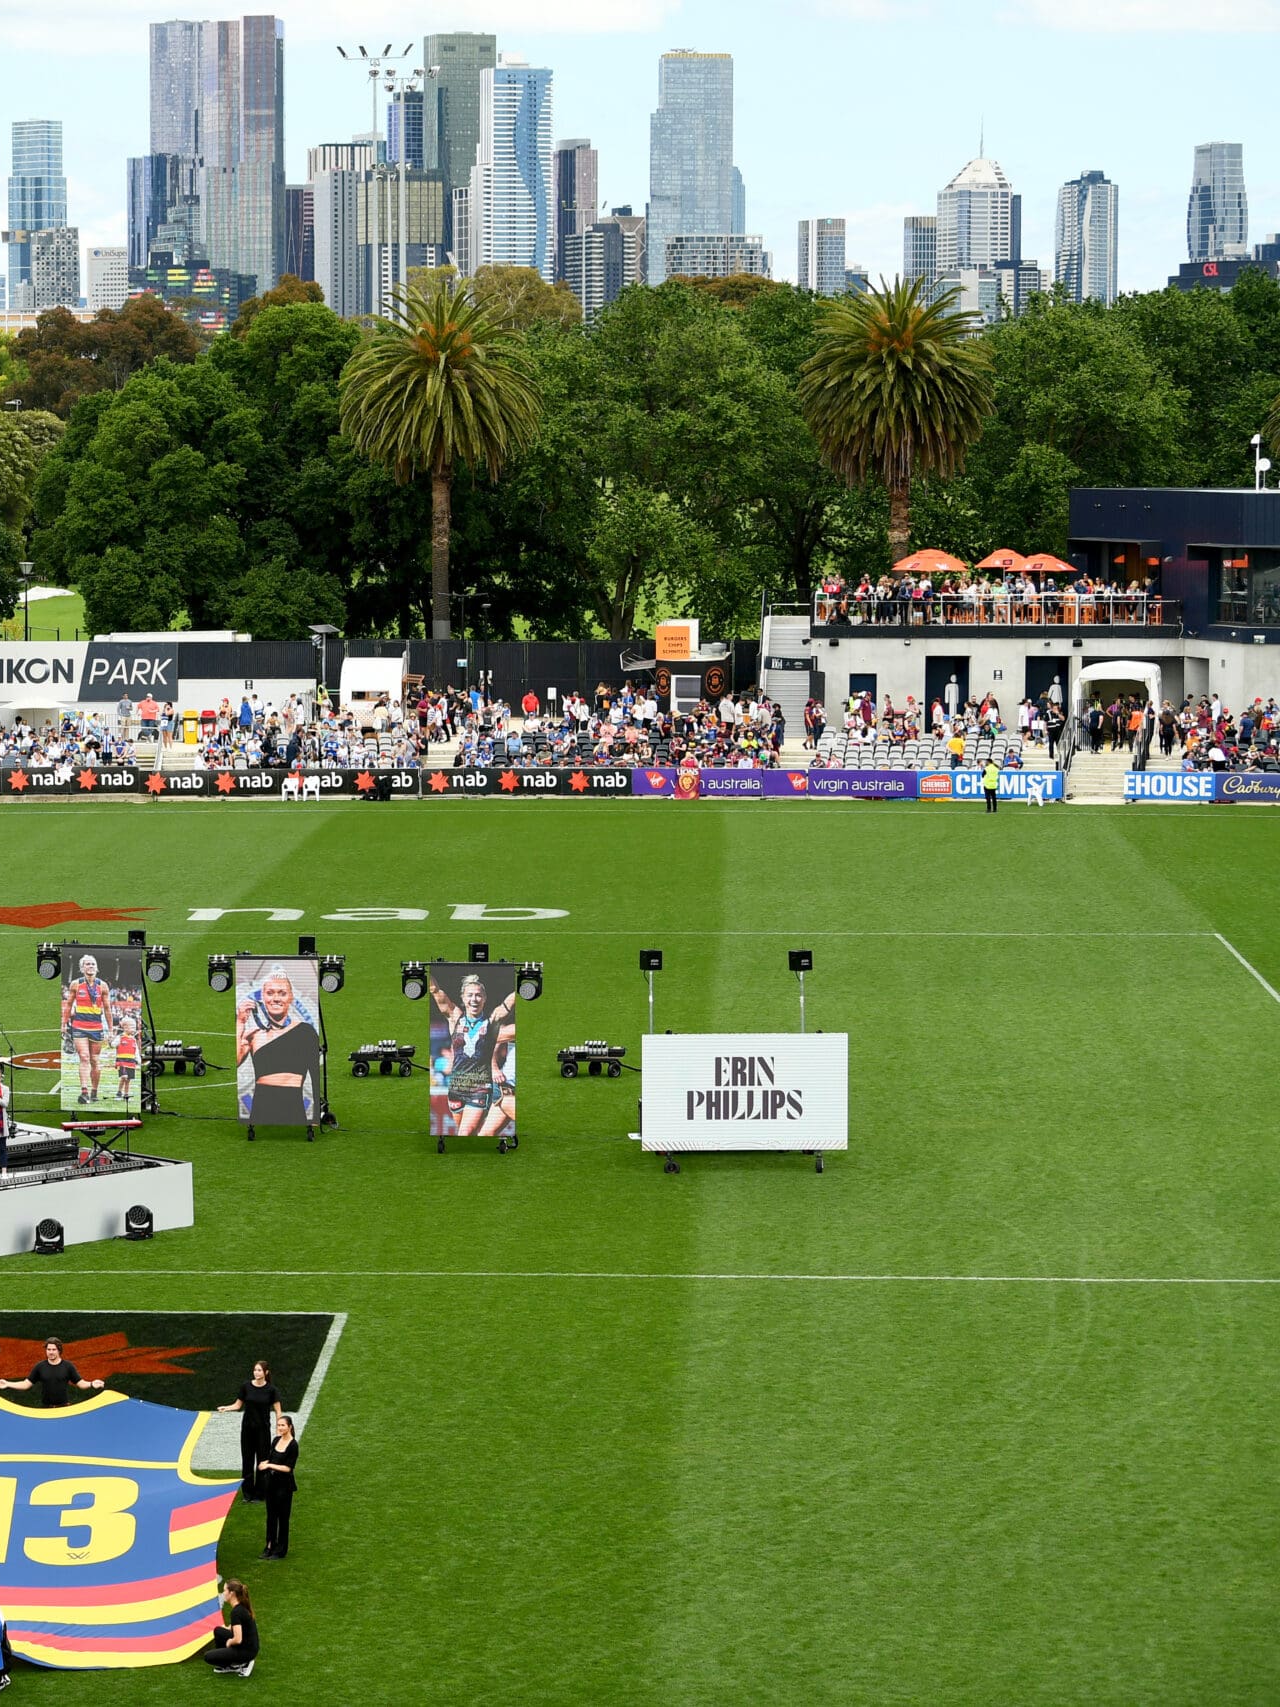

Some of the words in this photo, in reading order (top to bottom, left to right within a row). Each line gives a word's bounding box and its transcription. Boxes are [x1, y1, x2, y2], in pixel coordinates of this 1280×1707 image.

[1203, 263, 1219, 276] CSL
[88, 658, 173, 685] PARK
[101, 769, 134, 786] nab
[170, 772, 203, 789] nab
[239, 772, 273, 788] nab
[378, 772, 412, 788] ab
[452, 771, 487, 788] nab
[523, 771, 557, 788] nab
[593, 771, 627, 788] nab
[676, 768, 699, 776] LIONS
[708, 778, 761, 790] australia
[813, 778, 848, 793] virgin
[851, 779, 904, 791] australia
[956, 774, 1057, 795] CHMIST
[1124, 775, 1212, 797] EHOUSE
[1223, 775, 1280, 799] Cadbury
[186, 904, 571, 921] nab
[715, 1056, 774, 1087] ERIN
[686, 1089, 803, 1120] PHILLIPS
